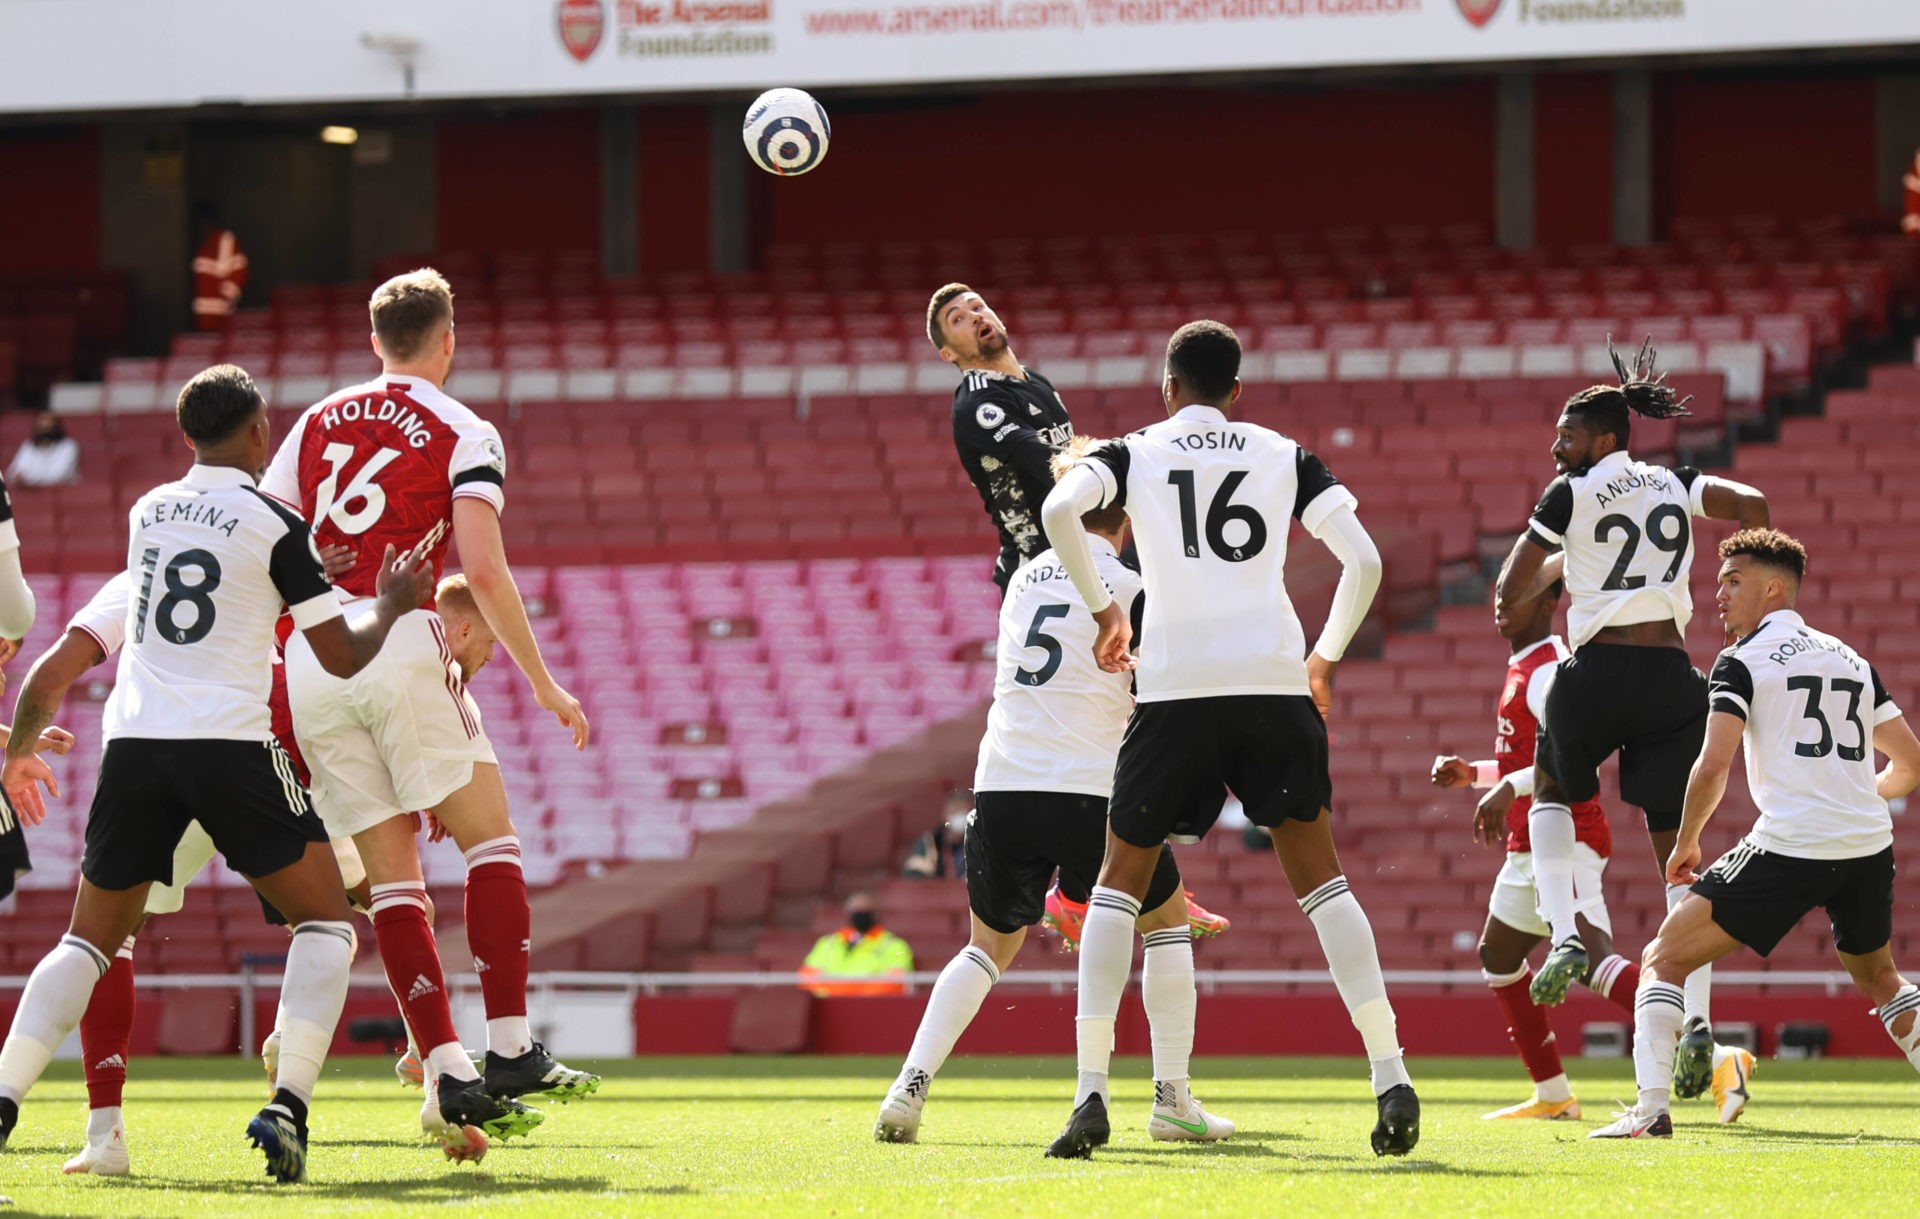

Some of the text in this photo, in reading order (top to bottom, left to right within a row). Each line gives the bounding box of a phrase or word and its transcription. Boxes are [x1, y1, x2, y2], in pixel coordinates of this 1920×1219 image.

[617, 30, 772, 57] Foundation
[323, 397, 432, 448] HOLDING
[1171, 431, 1246, 452] TOSIN
[140, 502, 240, 538] LEMINA
[311, 441, 402, 535] 16
[1167, 469, 1267, 562] 16
[1594, 502, 1690, 591] 29
[134, 547, 222, 645] 18
[1014, 603, 1071, 687] 5
[1769, 636, 1860, 671] ROBINSON
[1787, 675, 1866, 762] 33
[407, 984, 439, 1001] adidas
